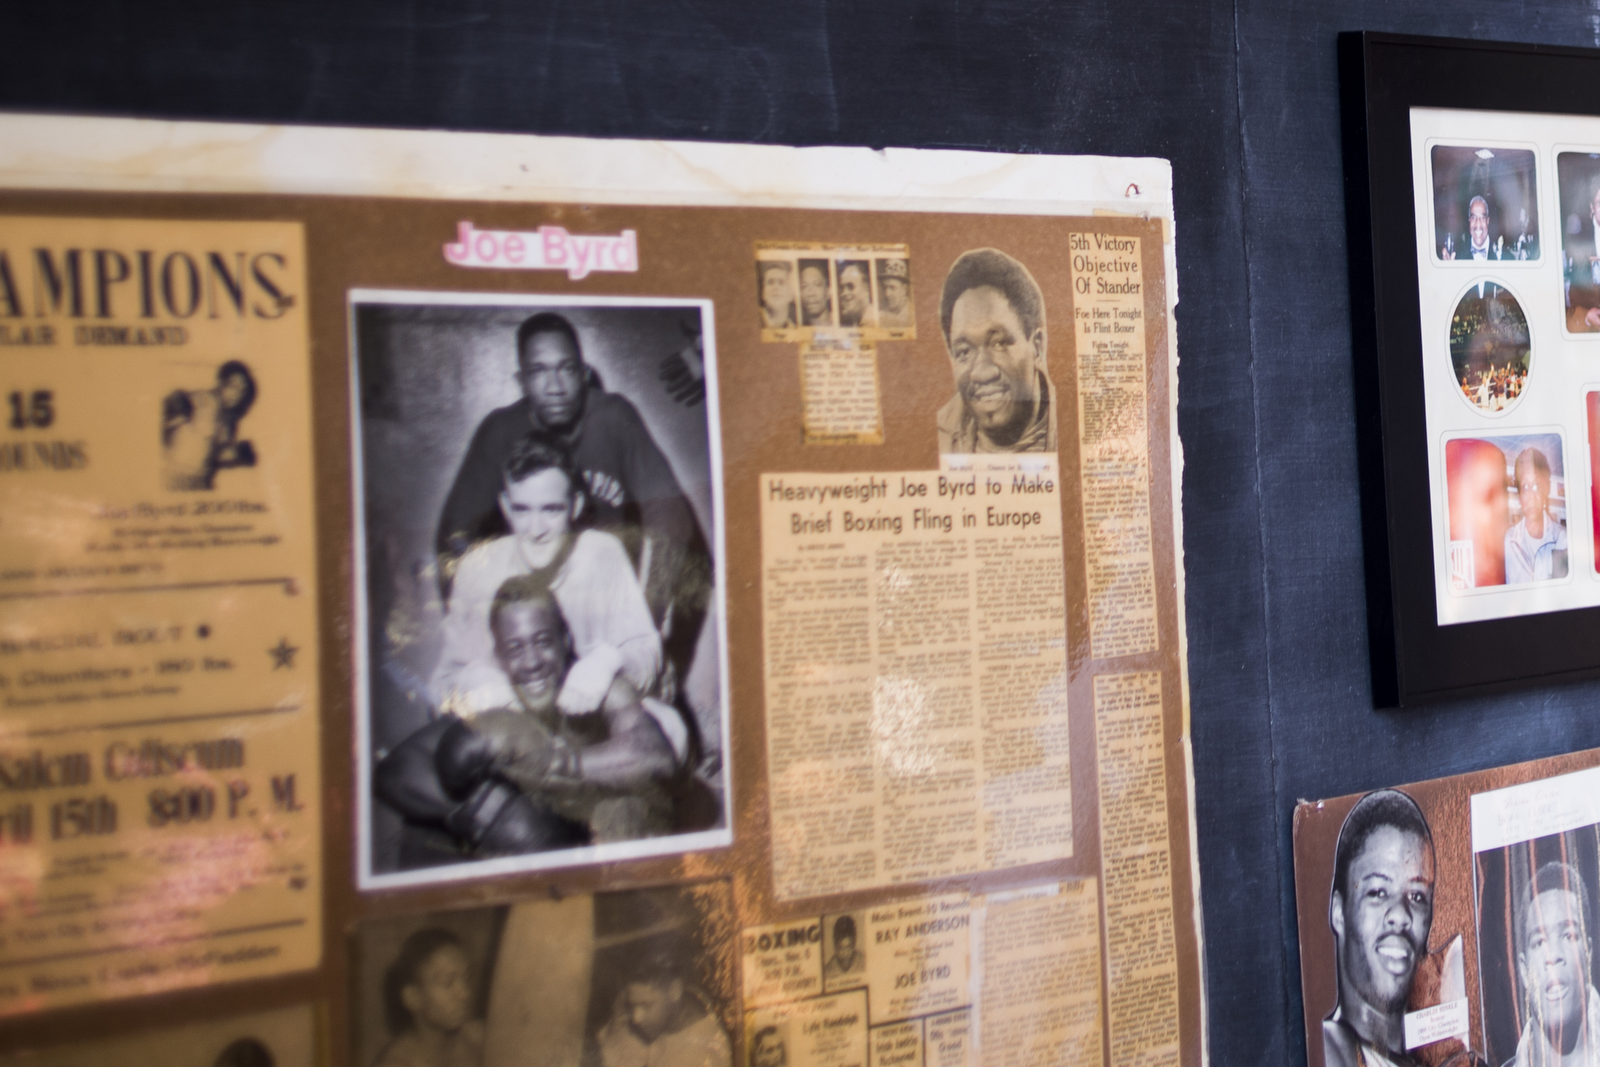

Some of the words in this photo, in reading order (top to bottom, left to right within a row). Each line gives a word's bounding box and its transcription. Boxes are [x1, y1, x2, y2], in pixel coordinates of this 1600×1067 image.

[443, 222, 525, 265] Joe
[539, 226, 636, 279] Byrd
[1070, 234, 1091, 251] 5th
[1094, 233, 1136, 254] Victory
[1073, 255, 1138, 275] Objective
[1075, 277, 1091, 294] Of
[1097, 277, 1141, 294] Stander
[1075, 307, 1090, 319] Foe
[1092, 307, 1111, 319] Here
[1113, 307, 1142, 321] Tonight
[73, 325, 190, 347] DEMAND
[1083, 322, 1091, 334] Is
[1093, 322, 1112, 334] Flint
[1113, 322, 1136, 334] Boxer
[9, 390, 55, 429] 15
[769, 477, 888, 505] Heavyweight
[898, 477, 928, 498] Joe
[937, 475, 976, 500] Byrd
[986, 477, 1002, 495] to
[1011, 474, 1054, 494] Make
[791, 510, 833, 535] Brief
[843, 509, 904, 534] Boxing
[913, 507, 953, 532] Fling
[962, 510, 977, 527] in
[986, 506, 1042, 529] Europe
[104, 737, 245, 783] Coliseum
[50, 794, 118, 840] 15th
[228, 779, 258, 818] P.
[871, 909, 896, 923] Main
[744, 924, 820, 955] BOXING
[875, 929, 900, 945] RAY
[905, 914, 970, 939] ANDERSON
[894, 972, 917, 990] JOE
[920, 965, 951, 984] BYRD
